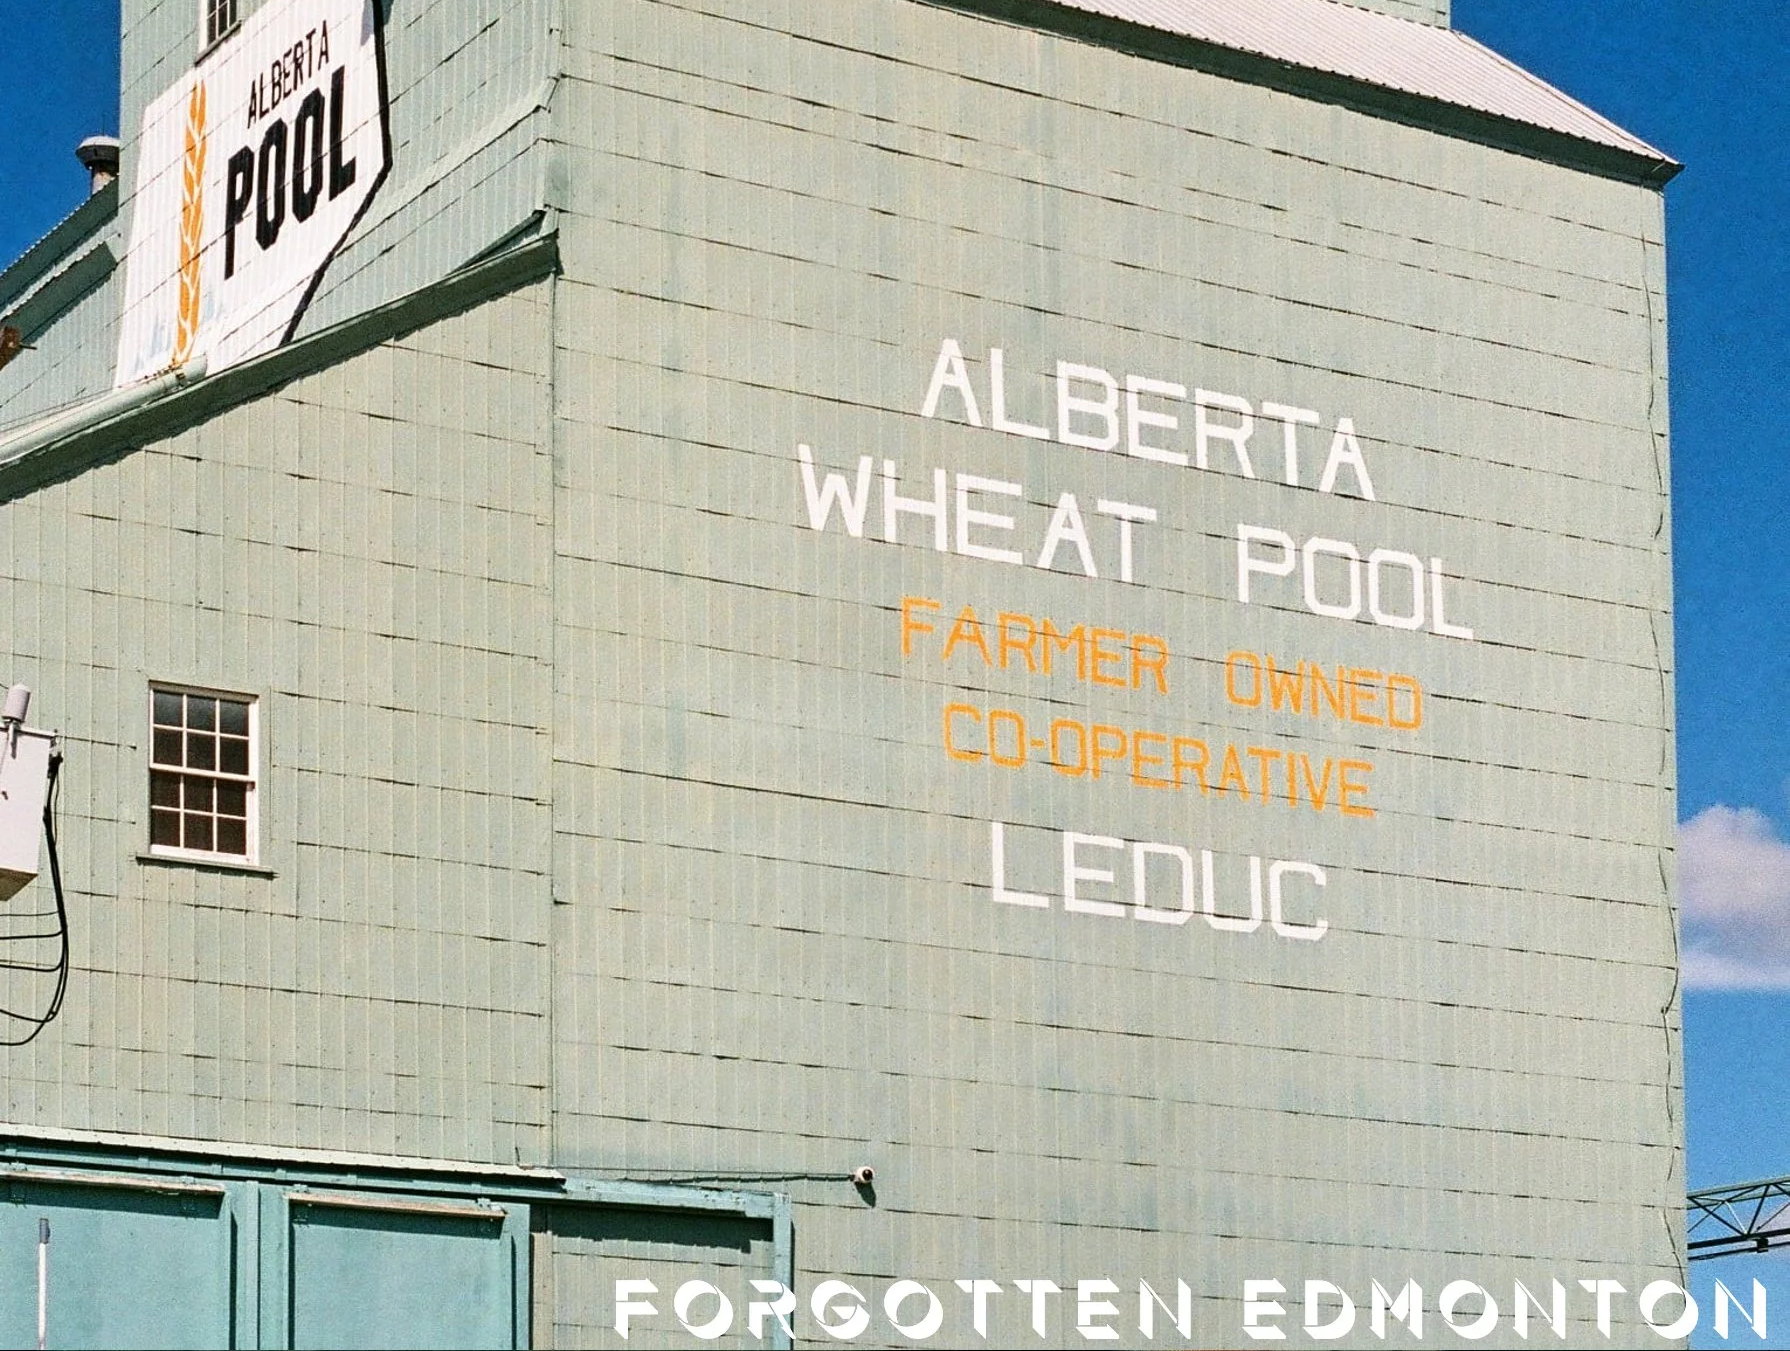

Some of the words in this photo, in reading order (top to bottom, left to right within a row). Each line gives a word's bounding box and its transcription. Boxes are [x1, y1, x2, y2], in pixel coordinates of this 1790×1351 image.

[247, 19, 330, 130] ALBERTA
[223, 66, 356, 280] POOL
[921, 339, 1376, 501] ALBERTA
[798, 443, 1157, 583] WHEAT
[1236, 523, 1474, 640] POOL
[901, 597, 1169, 694] FARMER
[1225, 651, 1424, 732] OWNED
[943, 703, 1376, 818] CO-OPERATIVE
[991, 822, 1329, 942] LEDUC
